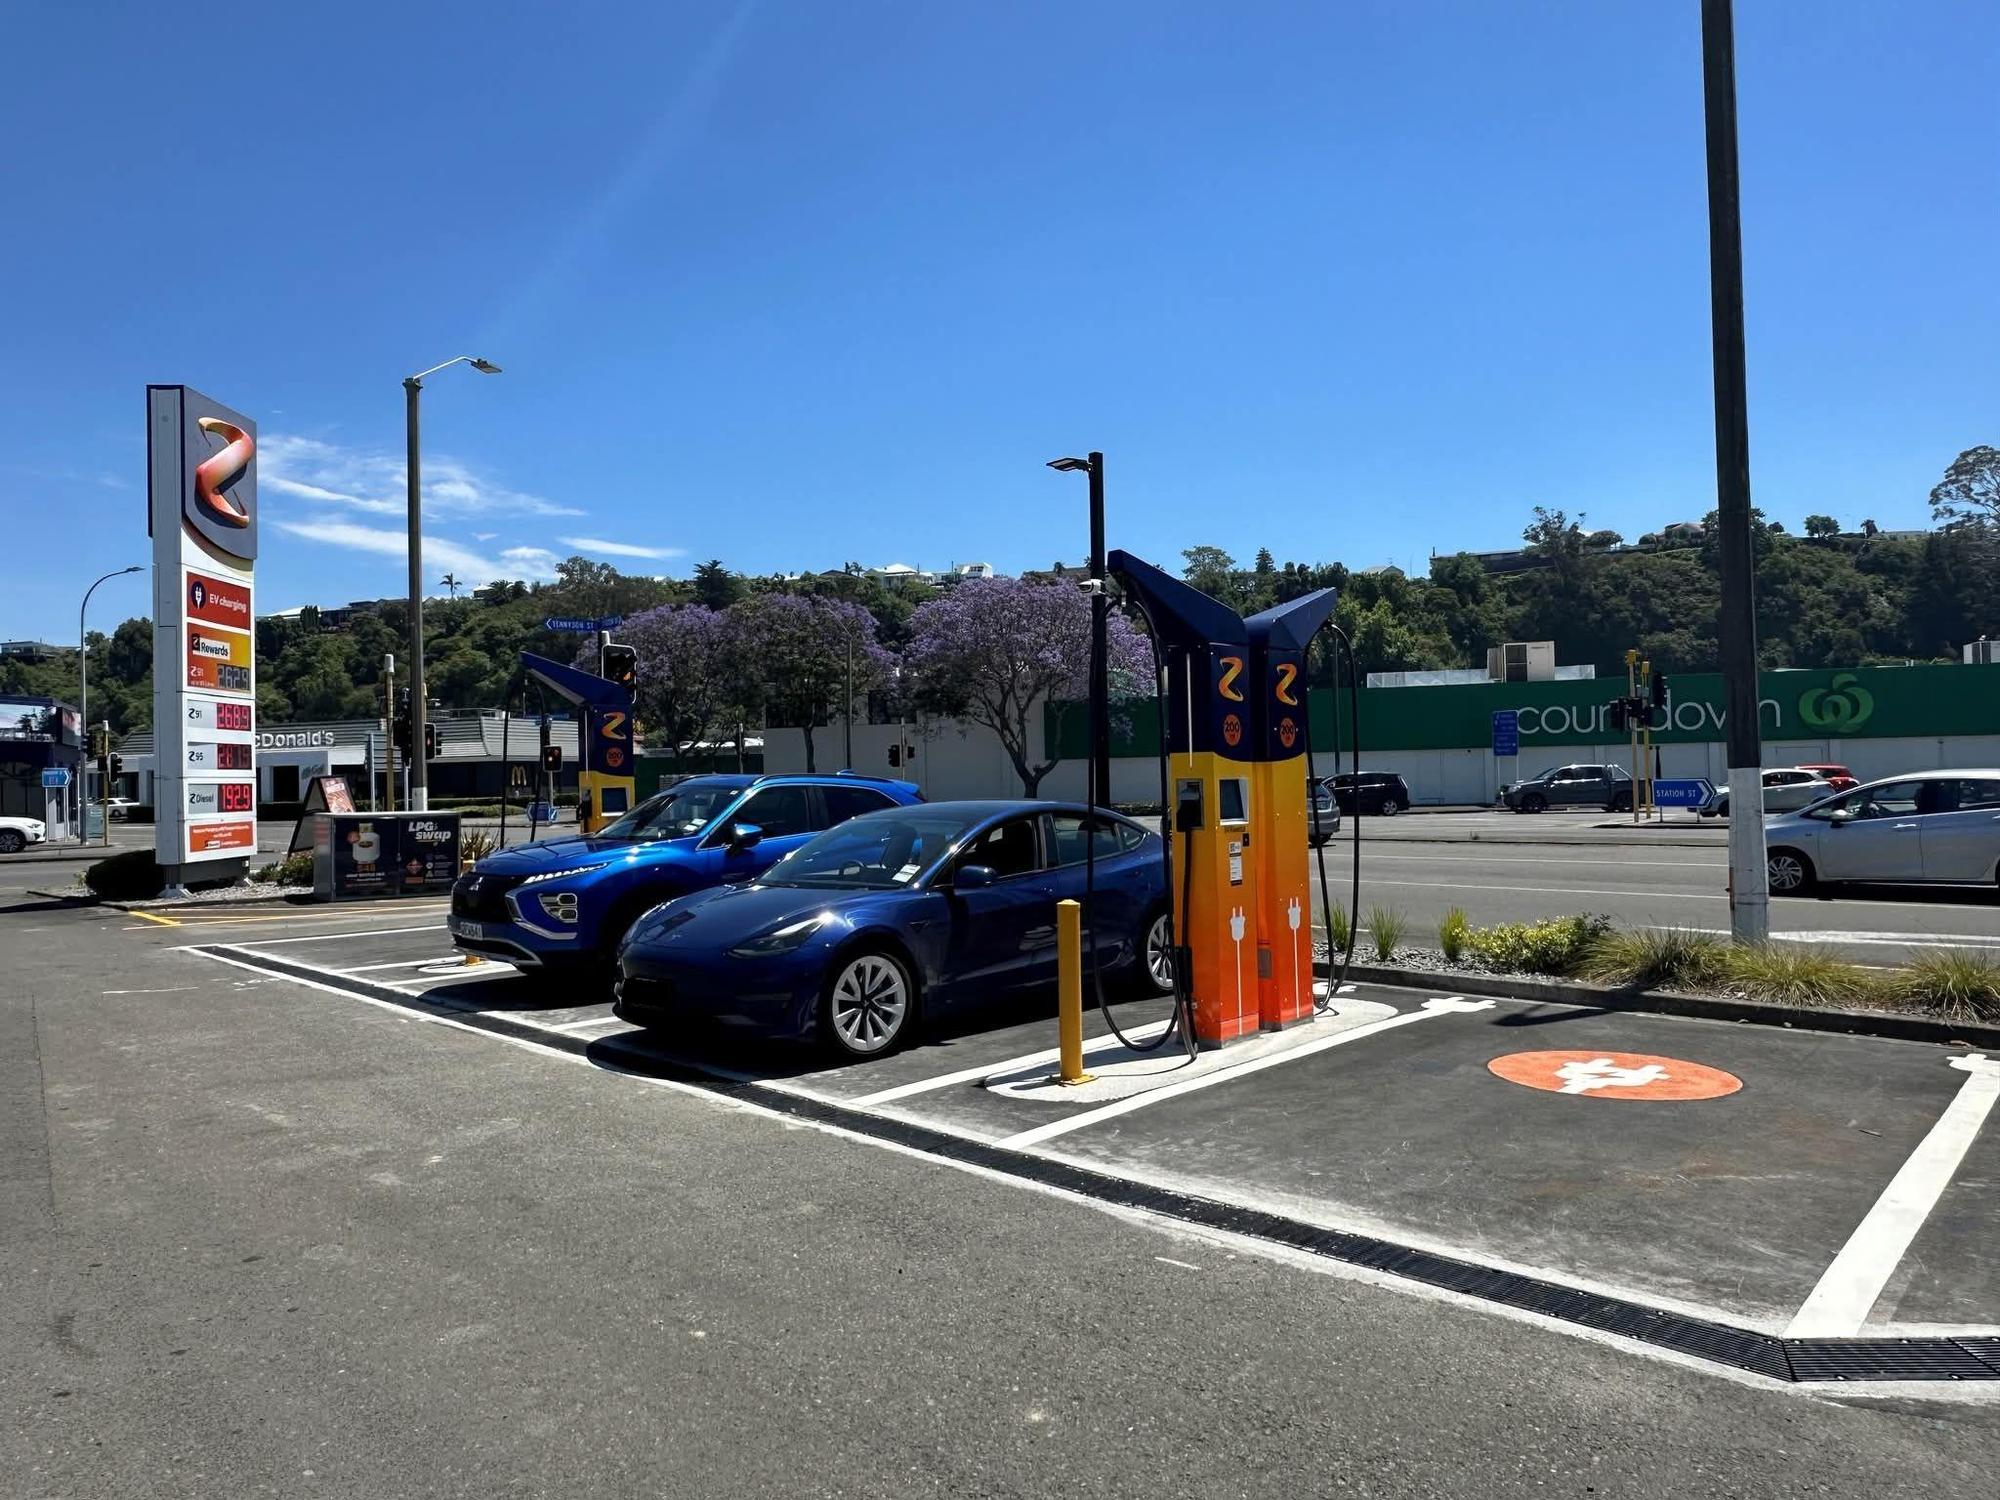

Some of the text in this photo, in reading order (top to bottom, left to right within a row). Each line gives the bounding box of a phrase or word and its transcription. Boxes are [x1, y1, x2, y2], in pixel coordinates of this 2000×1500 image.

[209, 593, 247, 613] EV charging
[201, 641, 228, 657] Rewards
[1224, 721, 1240, 732] 200
[254, 730, 334, 748] cDonald's
[196, 794, 214, 803] Diesel
[1656, 789, 1696, 798] STATION ST
[408, 821, 434, 832] LPG
[415, 830, 451, 842] swap
